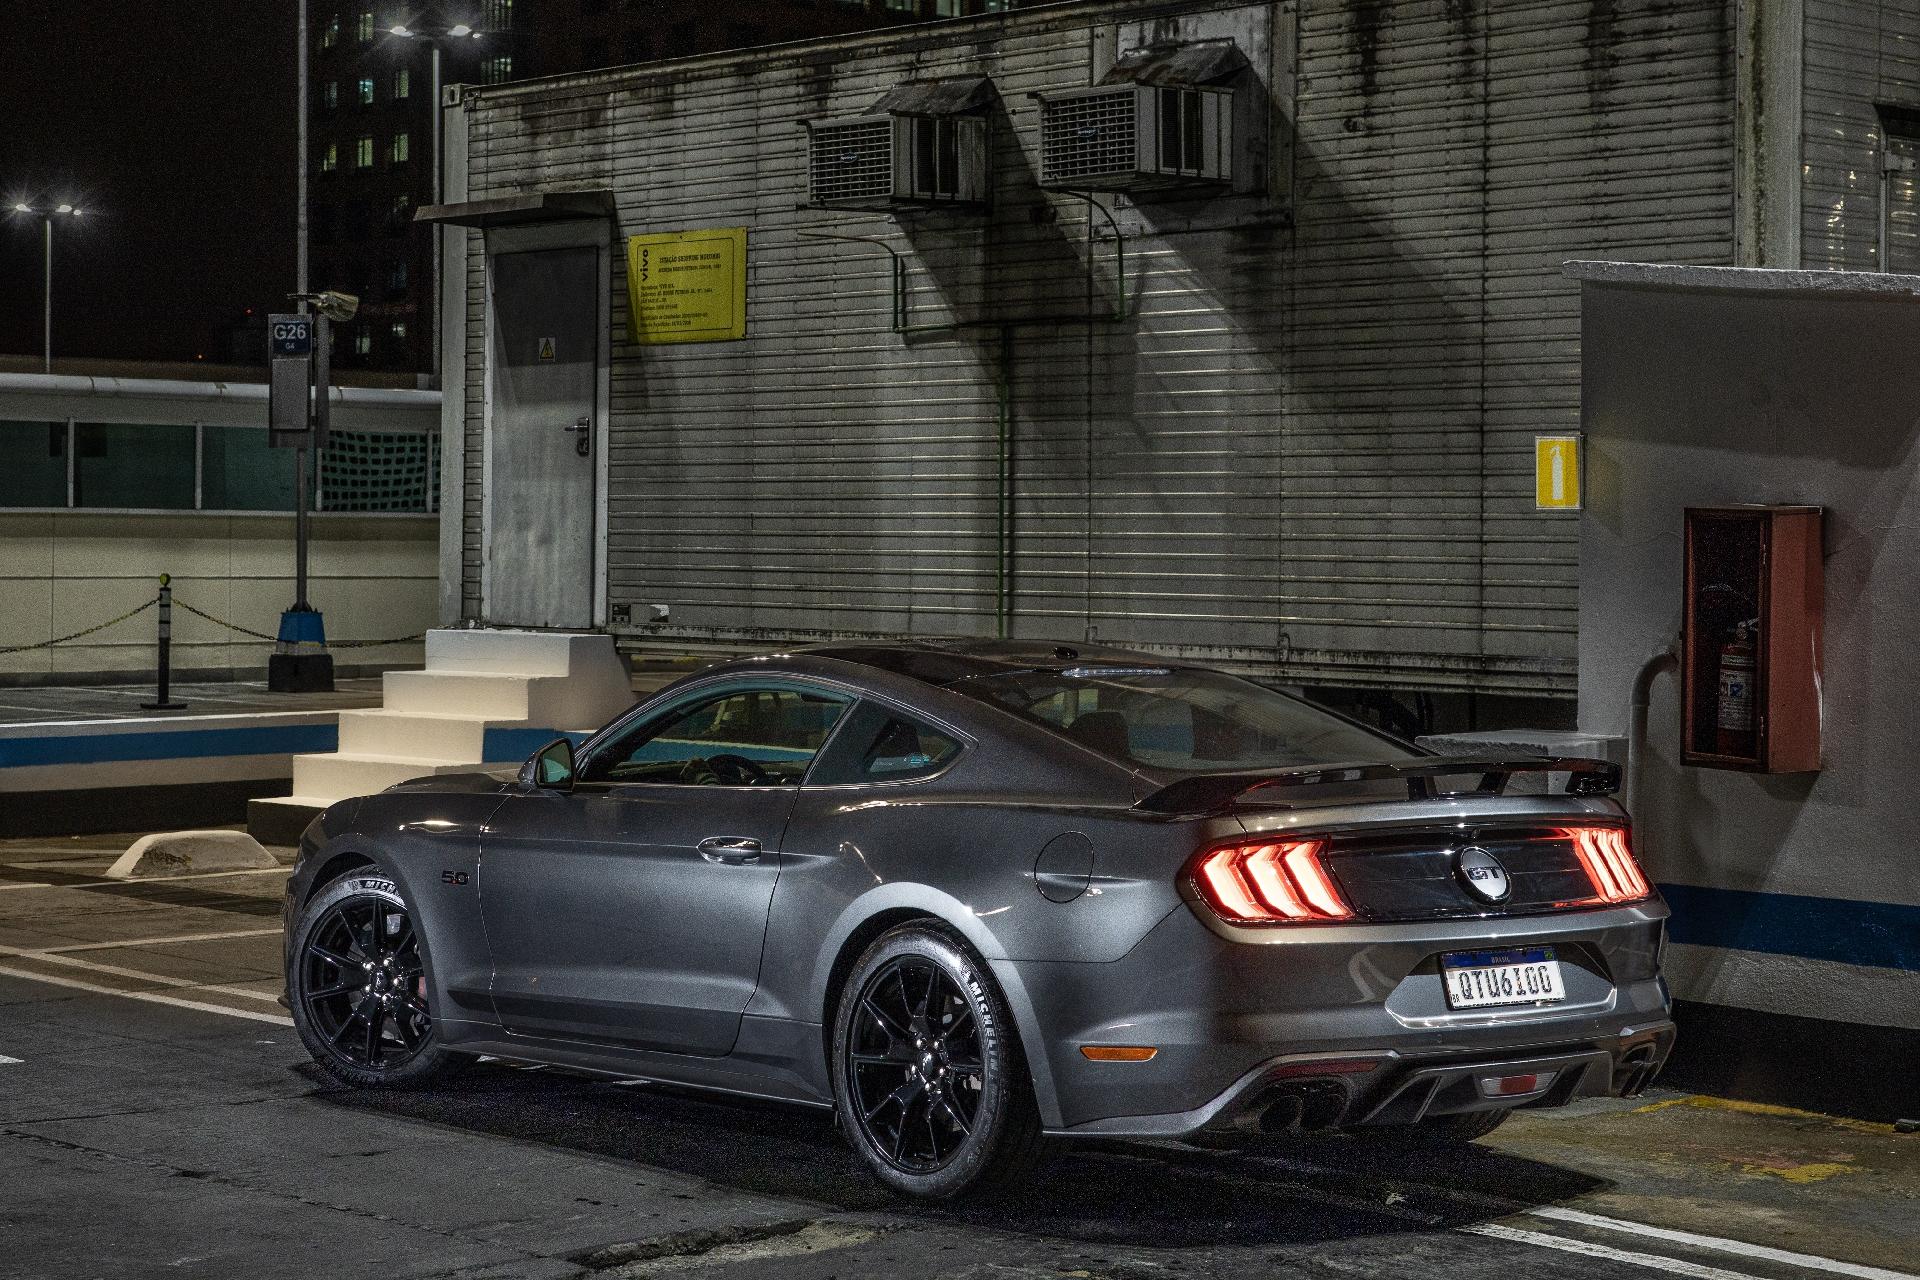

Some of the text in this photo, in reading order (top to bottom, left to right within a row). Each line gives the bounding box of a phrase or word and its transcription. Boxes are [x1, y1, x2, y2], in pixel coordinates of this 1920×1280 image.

[640, 249, 649, 282] vivo
[274, 324, 306, 340] G26
[1466, 866, 1501, 881] GT
[1491, 956, 1510, 964] BRASIL
